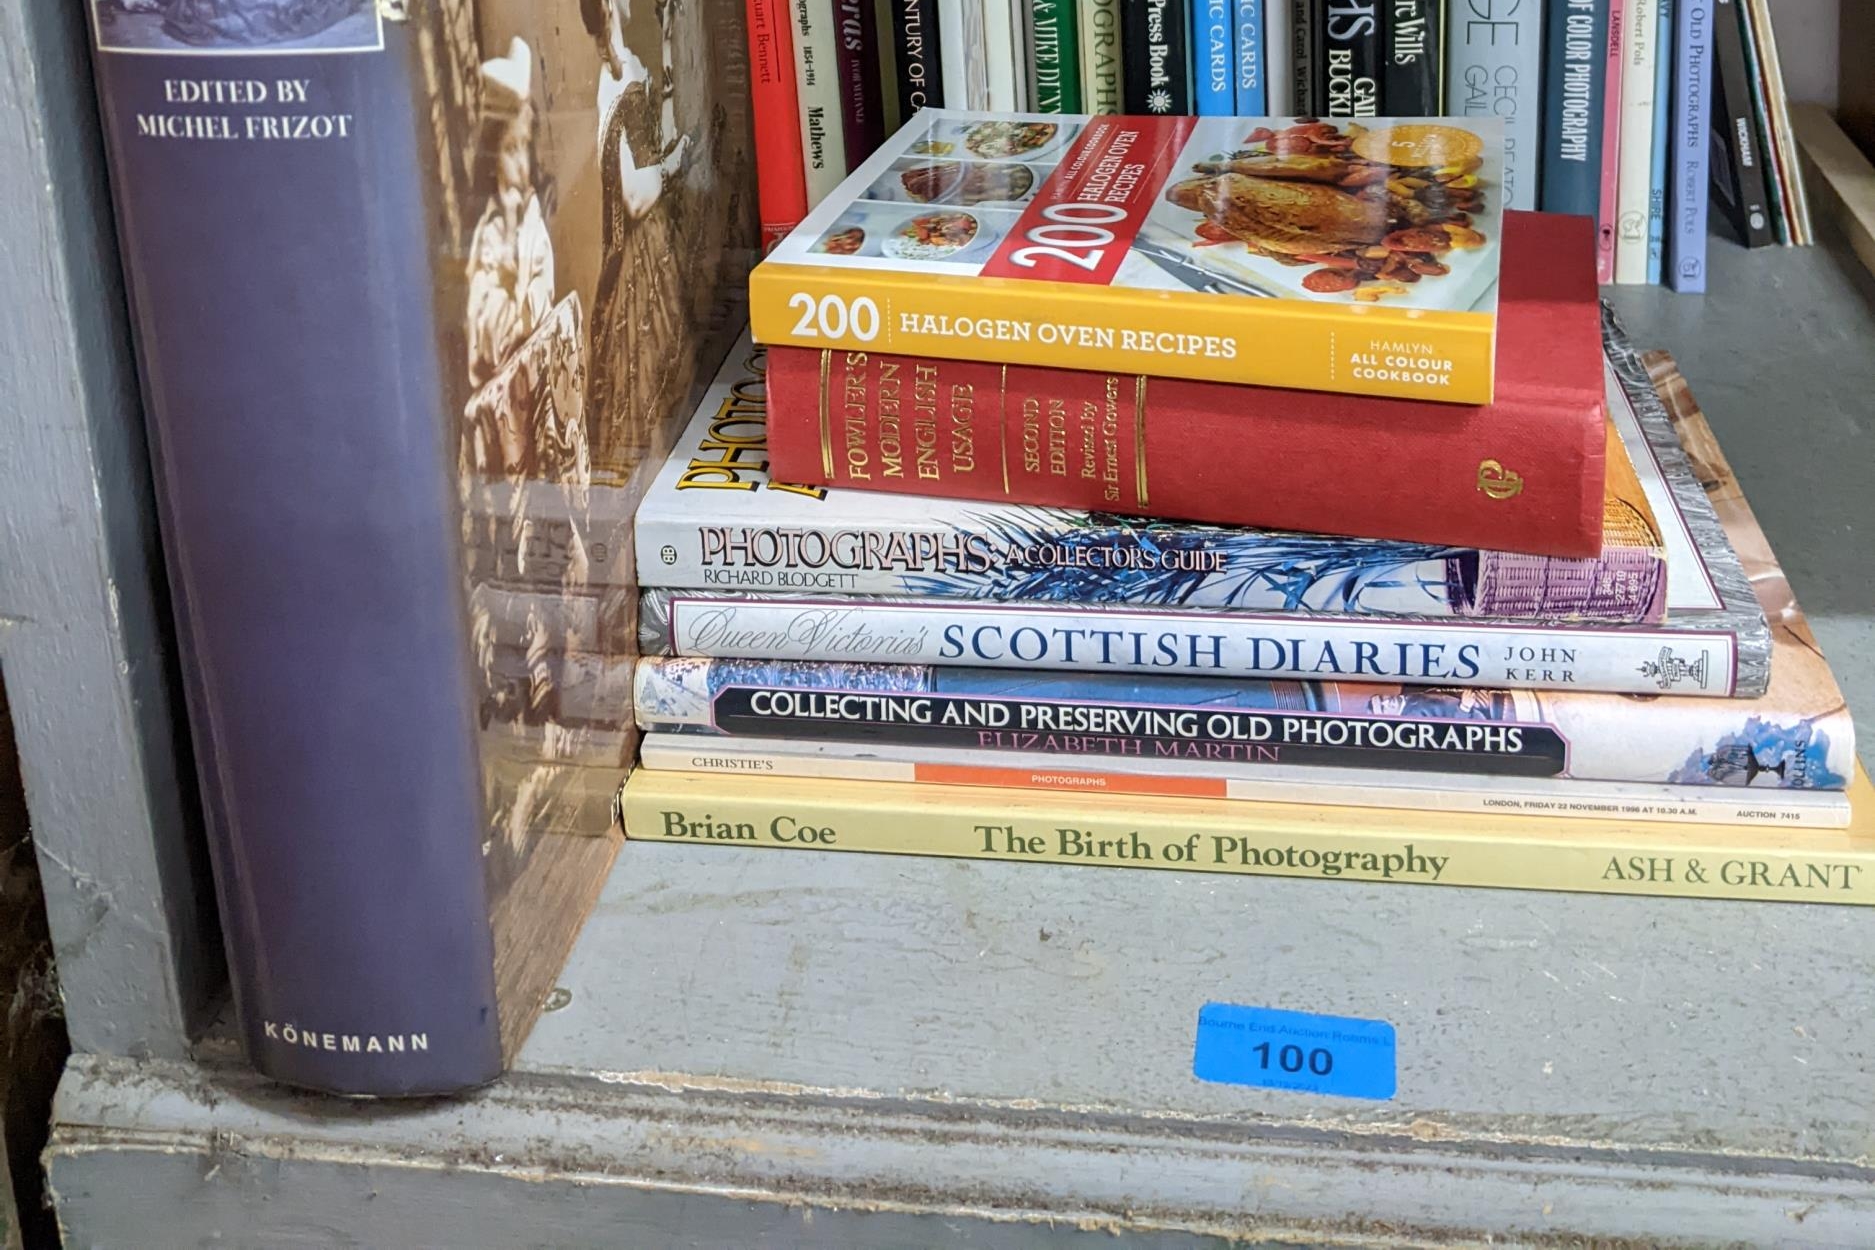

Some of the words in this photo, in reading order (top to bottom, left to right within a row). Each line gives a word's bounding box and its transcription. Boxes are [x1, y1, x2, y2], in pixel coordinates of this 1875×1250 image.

[1295, 0, 1306, 24] and
[1033, 17, 1060, 65] MIKE
[1240, 22, 1257, 90] CARDS
[1296, 26, 1307, 60] Carol
[1564, 15, 1594, 62] COLOR
[1632, 41, 1646, 66] Pols
[756, 33, 772, 85] Bennett
[1149, 44, 1169, 87] Book
[1209, 24, 1227, 93] CARDS
[163, 78, 268, 104] EDITED
[276, 78, 311, 103] BY
[136, 112, 239, 140] MICHEL
[246, 113, 353, 140] FRIZOT
[1559, 63, 1592, 163] PHOTOGRAPHY
[787, 291, 881, 342] 200
[899, 312, 1032, 342] HALOGEN
[1036, 322, 1116, 350] OVEN
[1120, 328, 1238, 359] RECIPES
[1350, 351, 1379, 367] ALL
[1384, 354, 1453, 372] COLOUR
[1369, 339, 1433, 356] HAMLYN
[1352, 366, 1451, 387] COOKBOOK
[846, 351, 872, 481] FOWLER'S
[878, 361, 905, 480] MODERN
[914, 363, 941, 481] ENGLISH
[1102, 376, 1119, 436] Gowers
[950, 382, 976, 474] USAGE
[1080, 425, 1096, 479] Revised
[1161, 548, 1229, 574] GUIDE
[703, 569, 774, 588] RICHARD
[777, 572, 859, 591] BLODGETT
[938, 623, 1228, 670] SCOTTISH
[1245, 635, 1480, 681] DIARIES
[1503, 645, 1577, 663] JOHN
[1504, 666, 1577, 683] KERR
[749, 690, 933, 724] COLLECTING
[939, 699, 1010, 729] AND
[1020, 705, 1199, 739] PRESERVING
[1206, 712, 1274, 742] OLD
[1282, 717, 1524, 755] PHOTOGRAPHS
[691, 756, 774, 771] CHRISTIE'S
[1154, 739, 1281, 763] MARTIN
[1031, 773, 1108, 787] PHOTOGRAPHS
[1482, 798, 1521, 810] LONDON,
[1524, 800, 1556, 811] FRIDAY
[1569, 803, 1619, 813] NOVEMBER
[1736, 810, 1776, 819] AUCTION
[658, 810, 759, 841] Brian
[768, 814, 838, 845] Coe
[973, 824, 1047, 856] The
[1055, 828, 1154, 861] Birth
[1161, 831, 1201, 864] of
[1209, 834, 1452, 881] Photography
[1599, 855, 1673, 885] ASH
[1683, 858, 1708, 886] &
[1718, 857, 1864, 892] GRANT
[1251, 1040, 1334, 1077] 100
